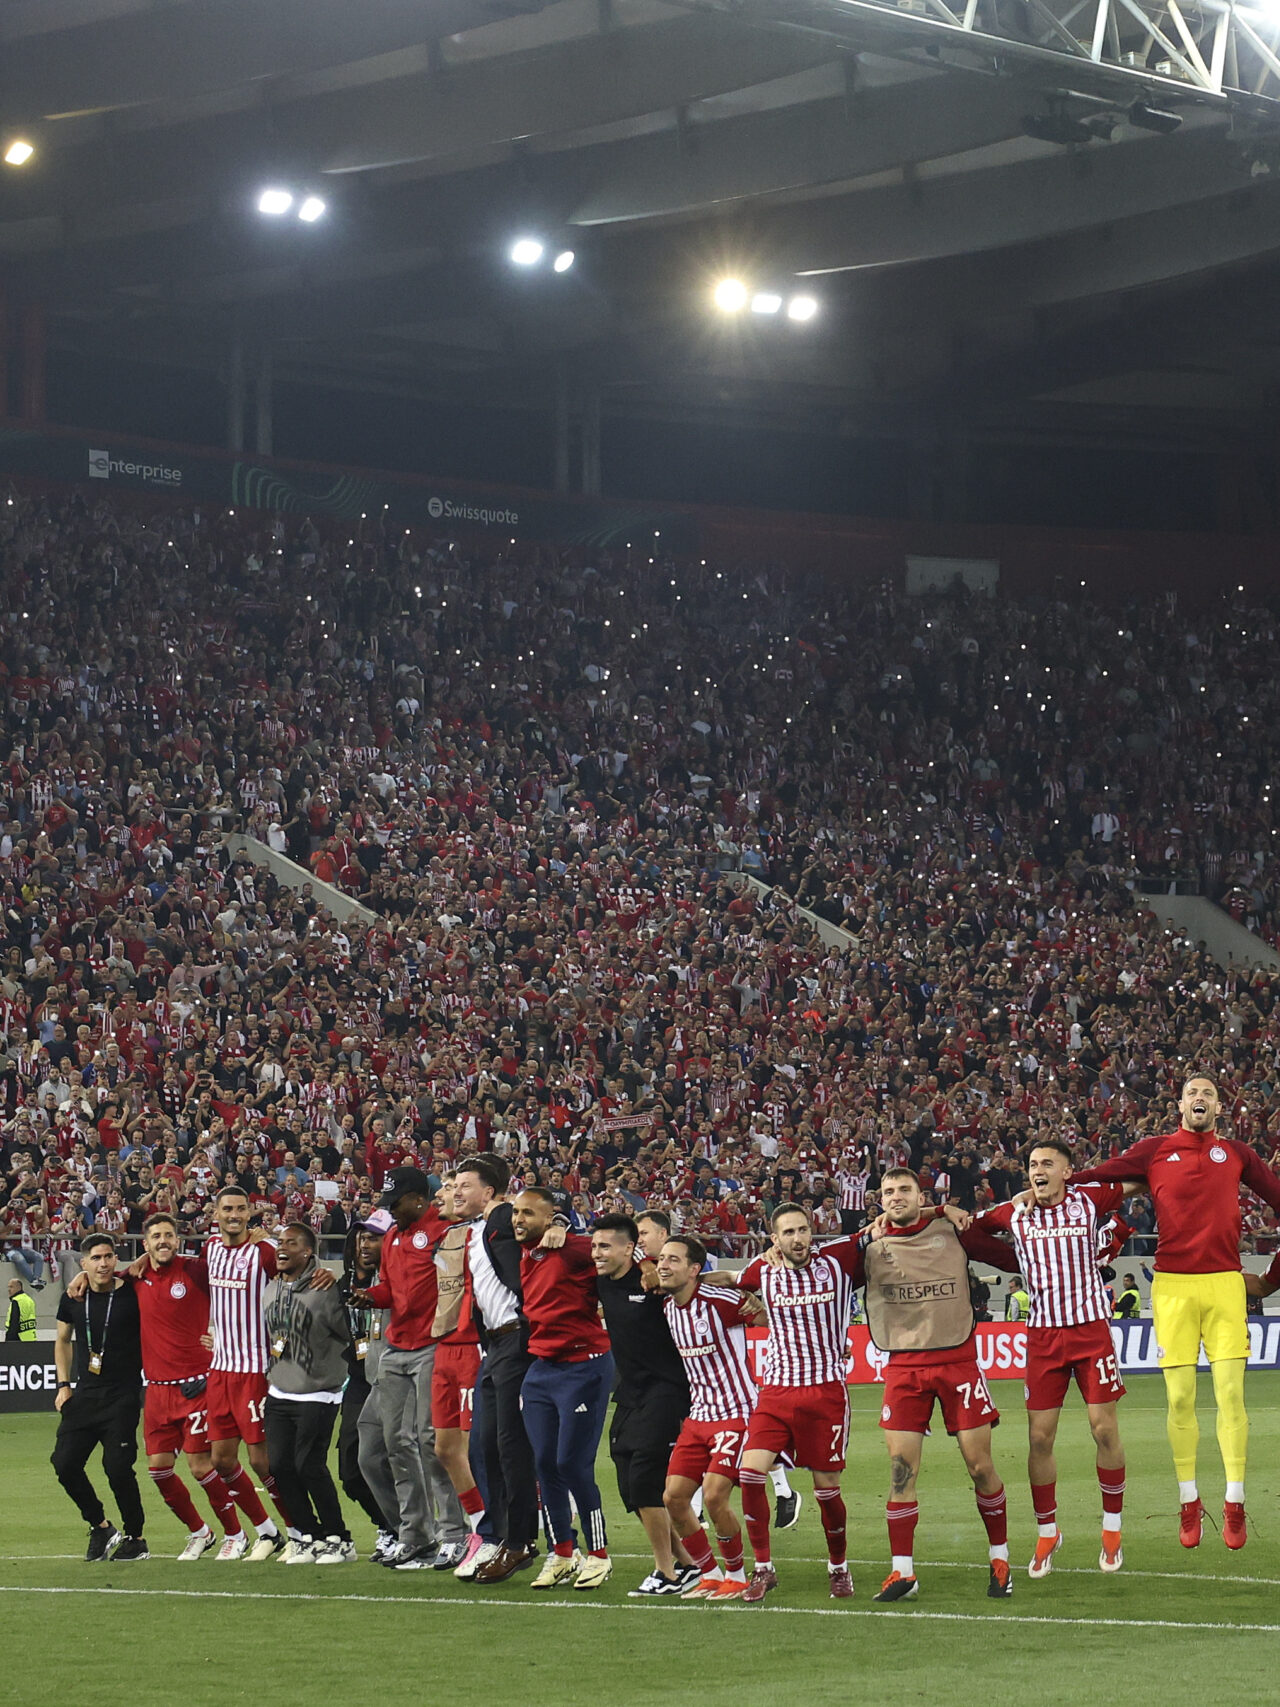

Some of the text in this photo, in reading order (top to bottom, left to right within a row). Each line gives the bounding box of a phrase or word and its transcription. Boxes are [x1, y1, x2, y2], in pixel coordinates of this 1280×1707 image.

[89, 452, 182, 480] enterprise
[444, 500, 519, 525] Swissquote
[1026, 1226, 1088, 1240] Stoiximan
[773, 1291, 835, 1307] Stoiximan
[899, 1282, 956, 1300] RESPECT
[1096, 1354, 1118, 1385] 15
[957, 1378, 989, 1409] 74
[831, 1425, 843, 1450] 7
